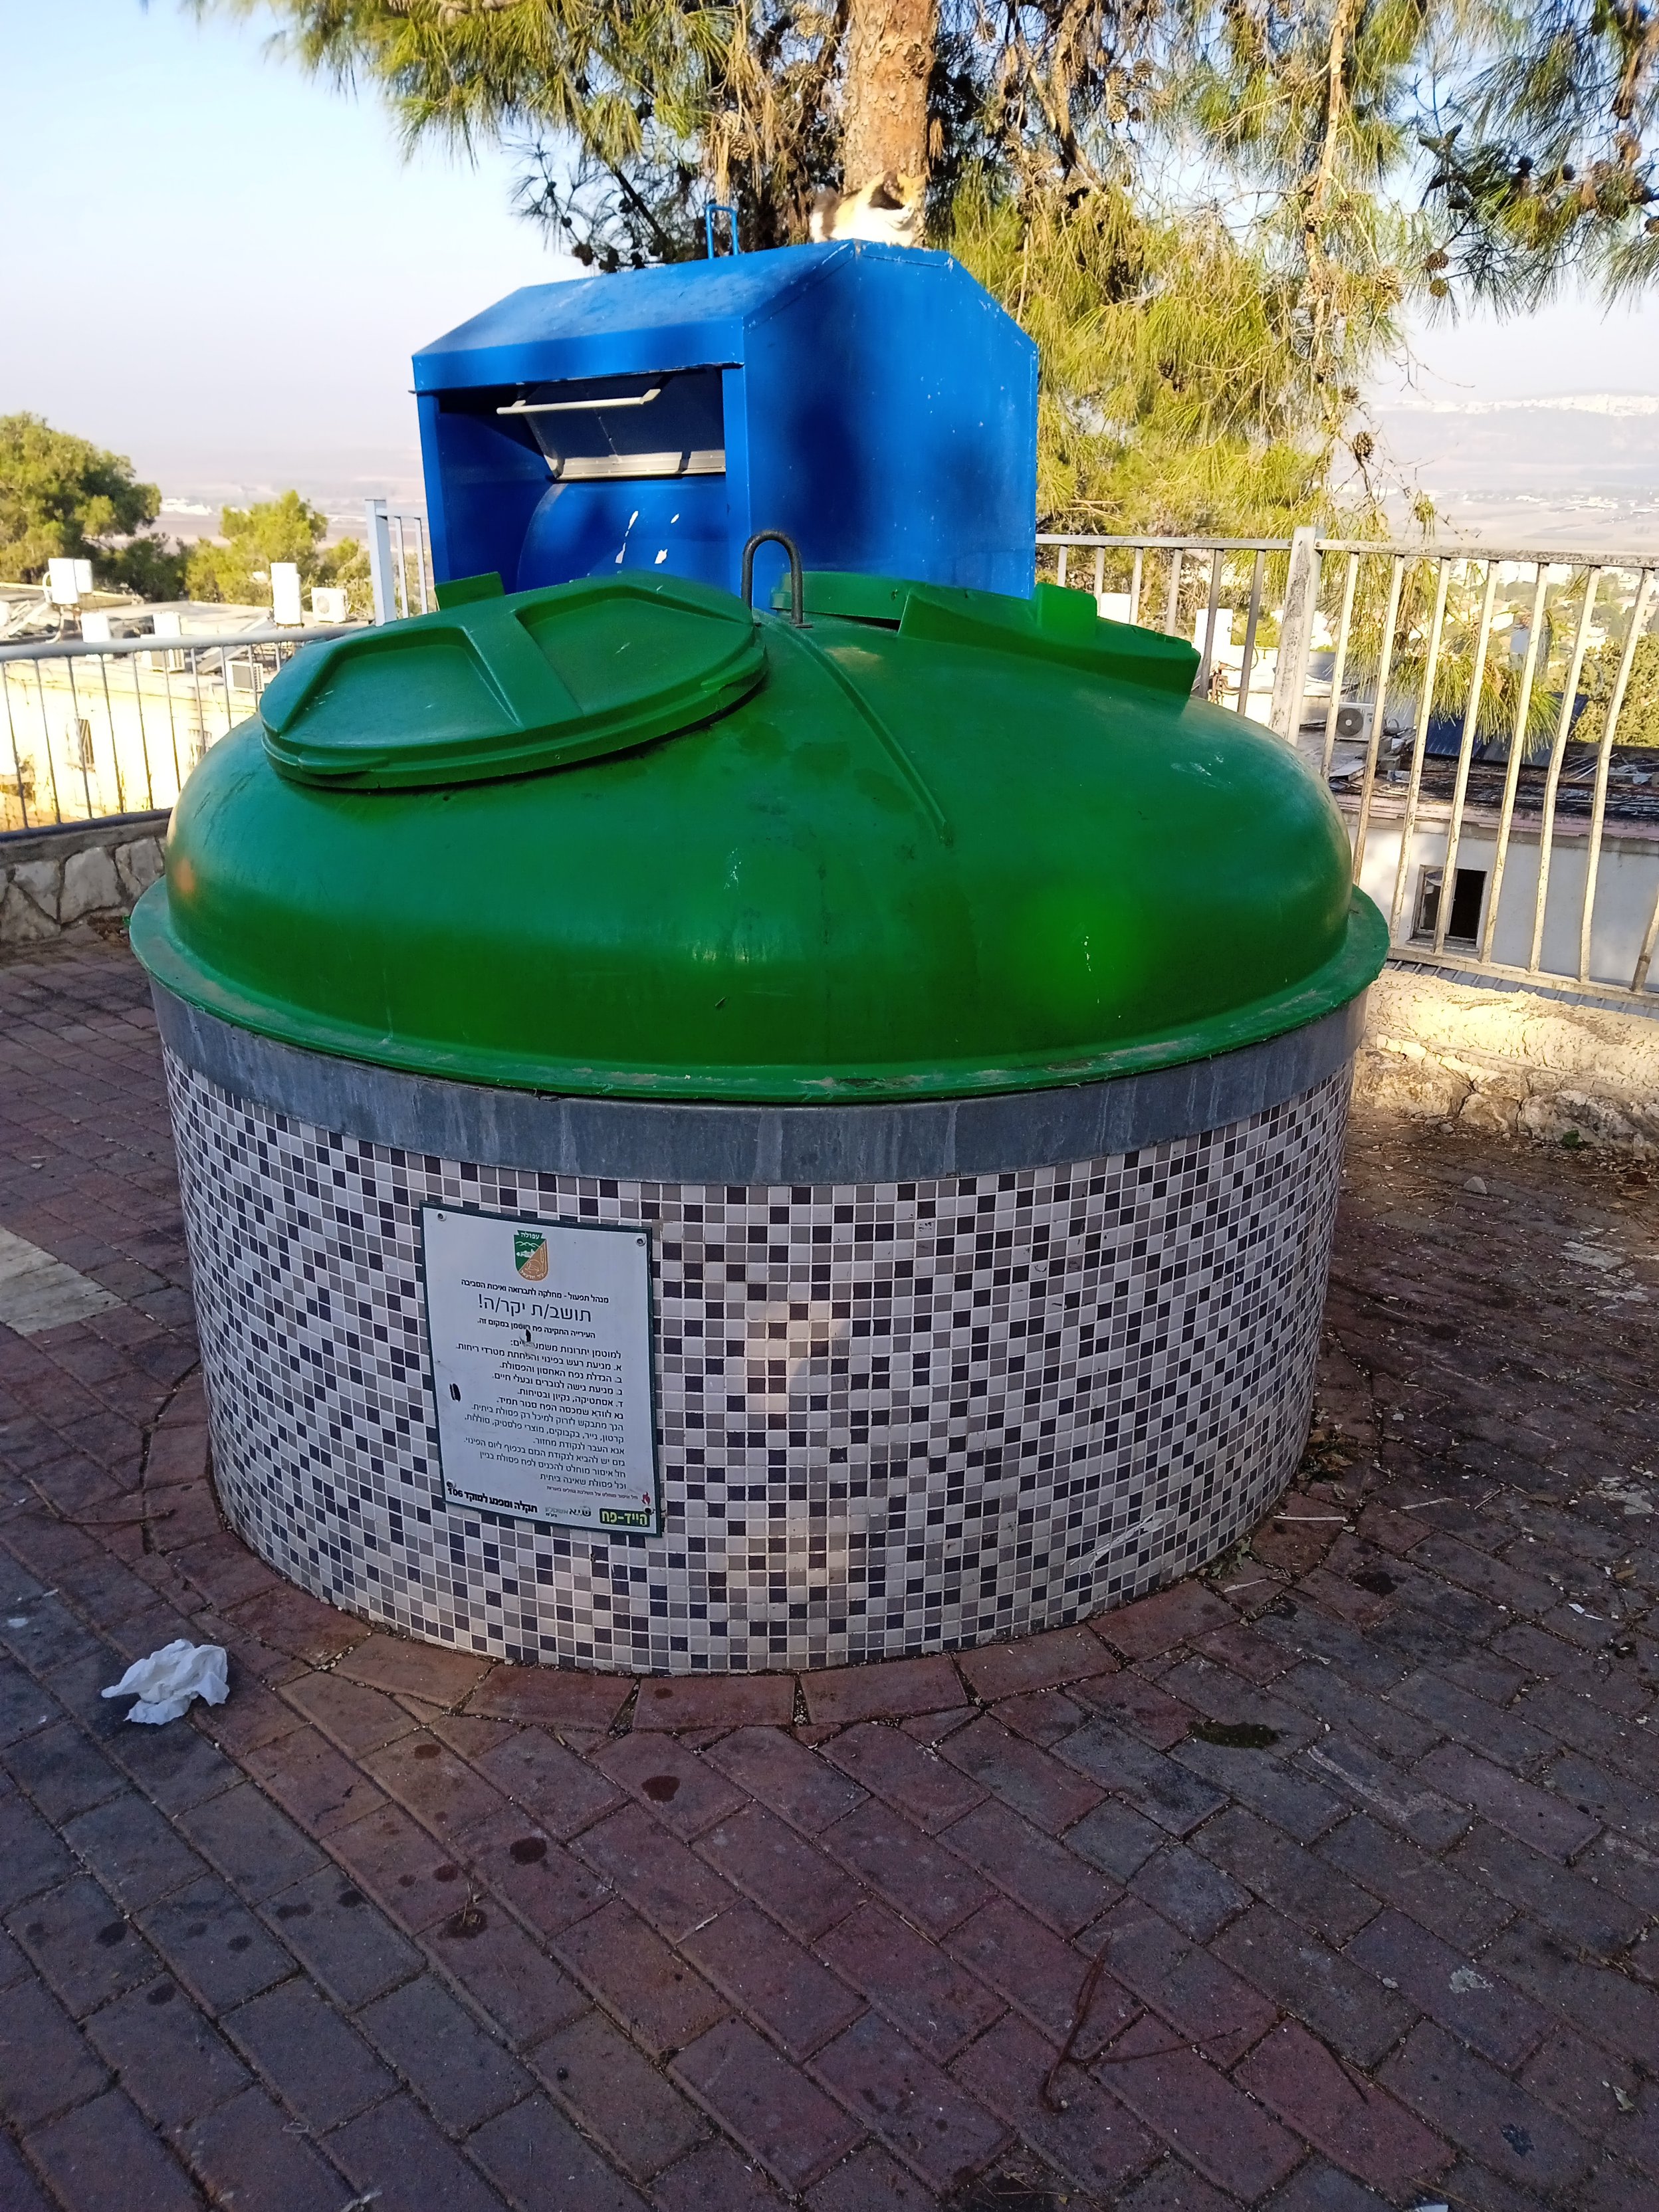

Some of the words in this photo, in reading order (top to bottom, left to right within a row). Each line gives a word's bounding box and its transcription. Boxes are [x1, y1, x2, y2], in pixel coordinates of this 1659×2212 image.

[461, 1279, 485, 1288] הסביבה
[508, 1286, 536, 1295] לתברואה
[568, 1292, 590, 1301] תפעול
[591, 1294, 609, 1303] מנהל
[479, 1293, 525, 1316] יקר/ה!
[531, 1304, 591, 1322] תושב/ת
[544, 1327, 569, 1335] התקינה
[570, 1330, 596, 1339] העירייה
[456, 1343, 479, 1352] ריחות.
[481, 1347, 504, 1356] מטרדי
[560, 1346, 590, 1355] יתרונות
[592, 1350, 621, 1359] למוטמן
[542, 1356, 564, 1365] בפינוי
[500, 1361, 534, 1373] והפסולת.
[586, 1361, 611, 1370] מניעת
[537, 1367, 566, 1377] האחסון
[513, 1374, 532, 1384] ובעלי
[586, 1372, 611, 1382] הגדלת
[518, 1388, 550, 1398] ובטיחות.
[589, 1386, 613, 1394] מניעת
[497, 1397, 518, 1406] תמיד.
[553, 1393, 570, 1402] נקיון
[572, 1396, 613, 1406] אסתטיקה,
[472, 1404, 493, 1412] ביתית.
[520, 1400, 537, 1408] סגור
[496, 1406, 518, 1416] פסולת
[560, 1406, 589, 1415] שמכסה
[465, 1413, 491, 1424] סוללות,
[532, 1412, 553, 1422] למיכל
[492, 1419, 522, 1429] פלסטיק,
[578, 1420, 607, 1428] מתבקש
[546, 1428, 580, 1438] בקבוקים,
[533, 1438, 556, 1446] מחזור.
[600, 1435, 624, 1444] קרטון,
[504, 1444, 526, 1454] בכפוף
[559, 1442, 585, 1450] לנקודת
[497, 1453, 519, 1464] פסולת
[548, 1452, 574, 1461] לנקודת
[576, 1455, 598, 1464] להביא
[538, 1462, 563, 1471] להכניס
[566, 1464, 590, 1474] מוחלט
[592, 1468, 613, 1477] איסור
[588, 1478, 612, 1488] פסולת
[447, 1488, 463, 1497] 106
[464, 1493, 488, 1503] למוקד
[489, 1497, 512, 1508] ומפגע
[514, 1500, 538, 1513] תקלה
[602, 1511, 647, 1525] הייד-פח
